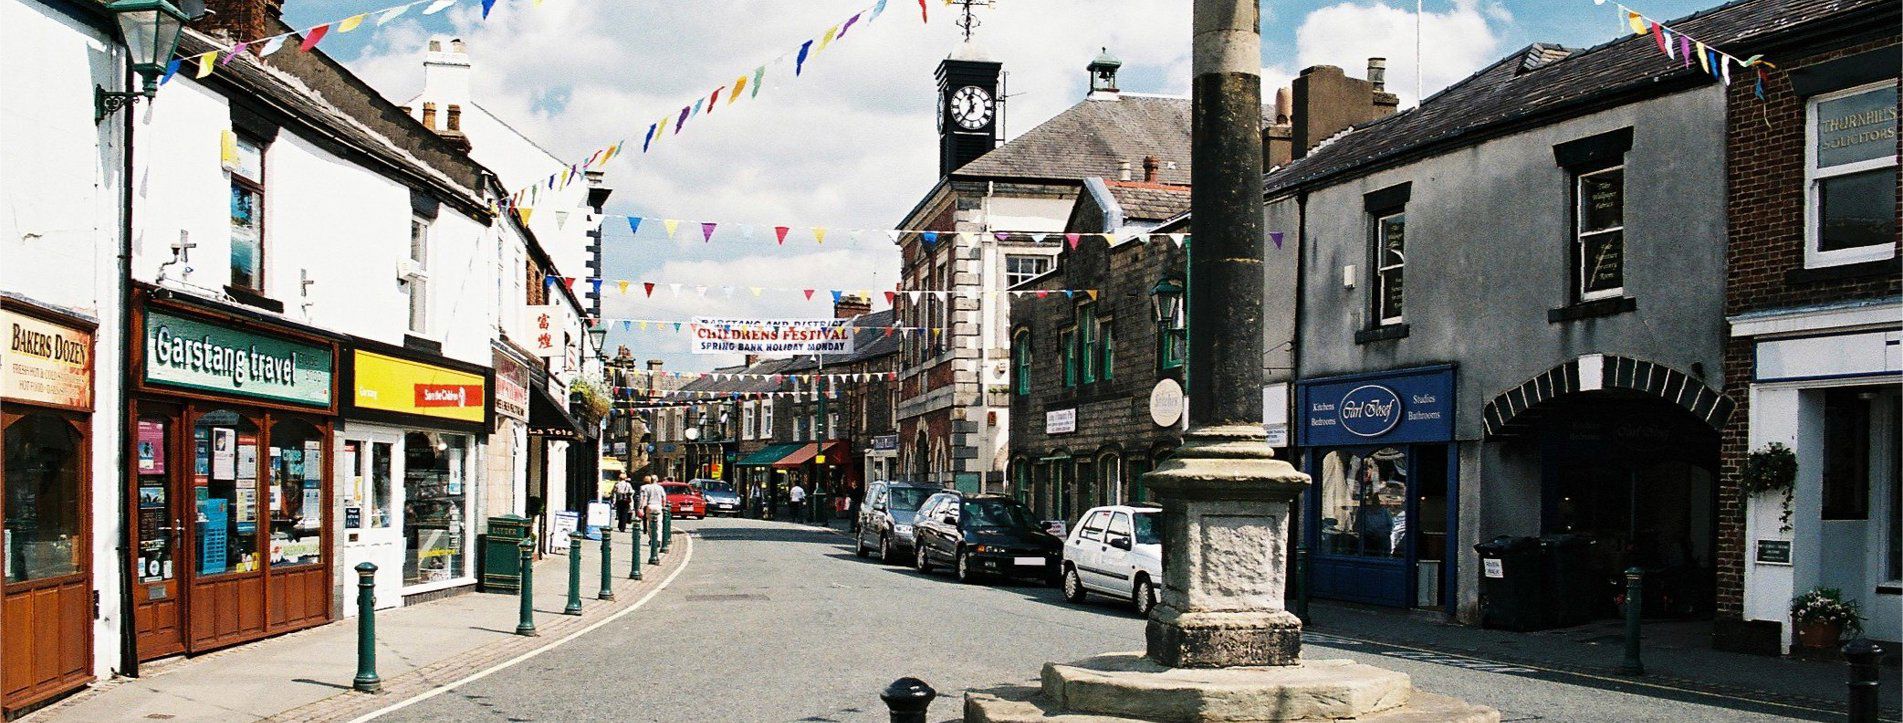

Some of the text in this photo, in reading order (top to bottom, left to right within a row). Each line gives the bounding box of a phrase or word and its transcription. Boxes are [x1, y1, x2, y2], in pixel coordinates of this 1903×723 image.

[1822, 106, 1897, 133] THORNHILLS
[1822, 127, 1895, 150] SOLICITORS
[782, 328, 849, 340] FESTIVAL
[11, 322, 86, 365] BAKERS DOZEN
[701, 341, 846, 351] SPRING BANK HOLIDAY MONDAY
[156, 325, 297, 387] Garstang travel
[1412, 393, 1436, 404] Studies
[1312, 402, 1335, 412] Kitchens
[1342, 398, 1395, 422] Carl Josef
[1311, 417, 1336, 426] Bedrooms
[1407, 410, 1441, 421] Bathrooms
